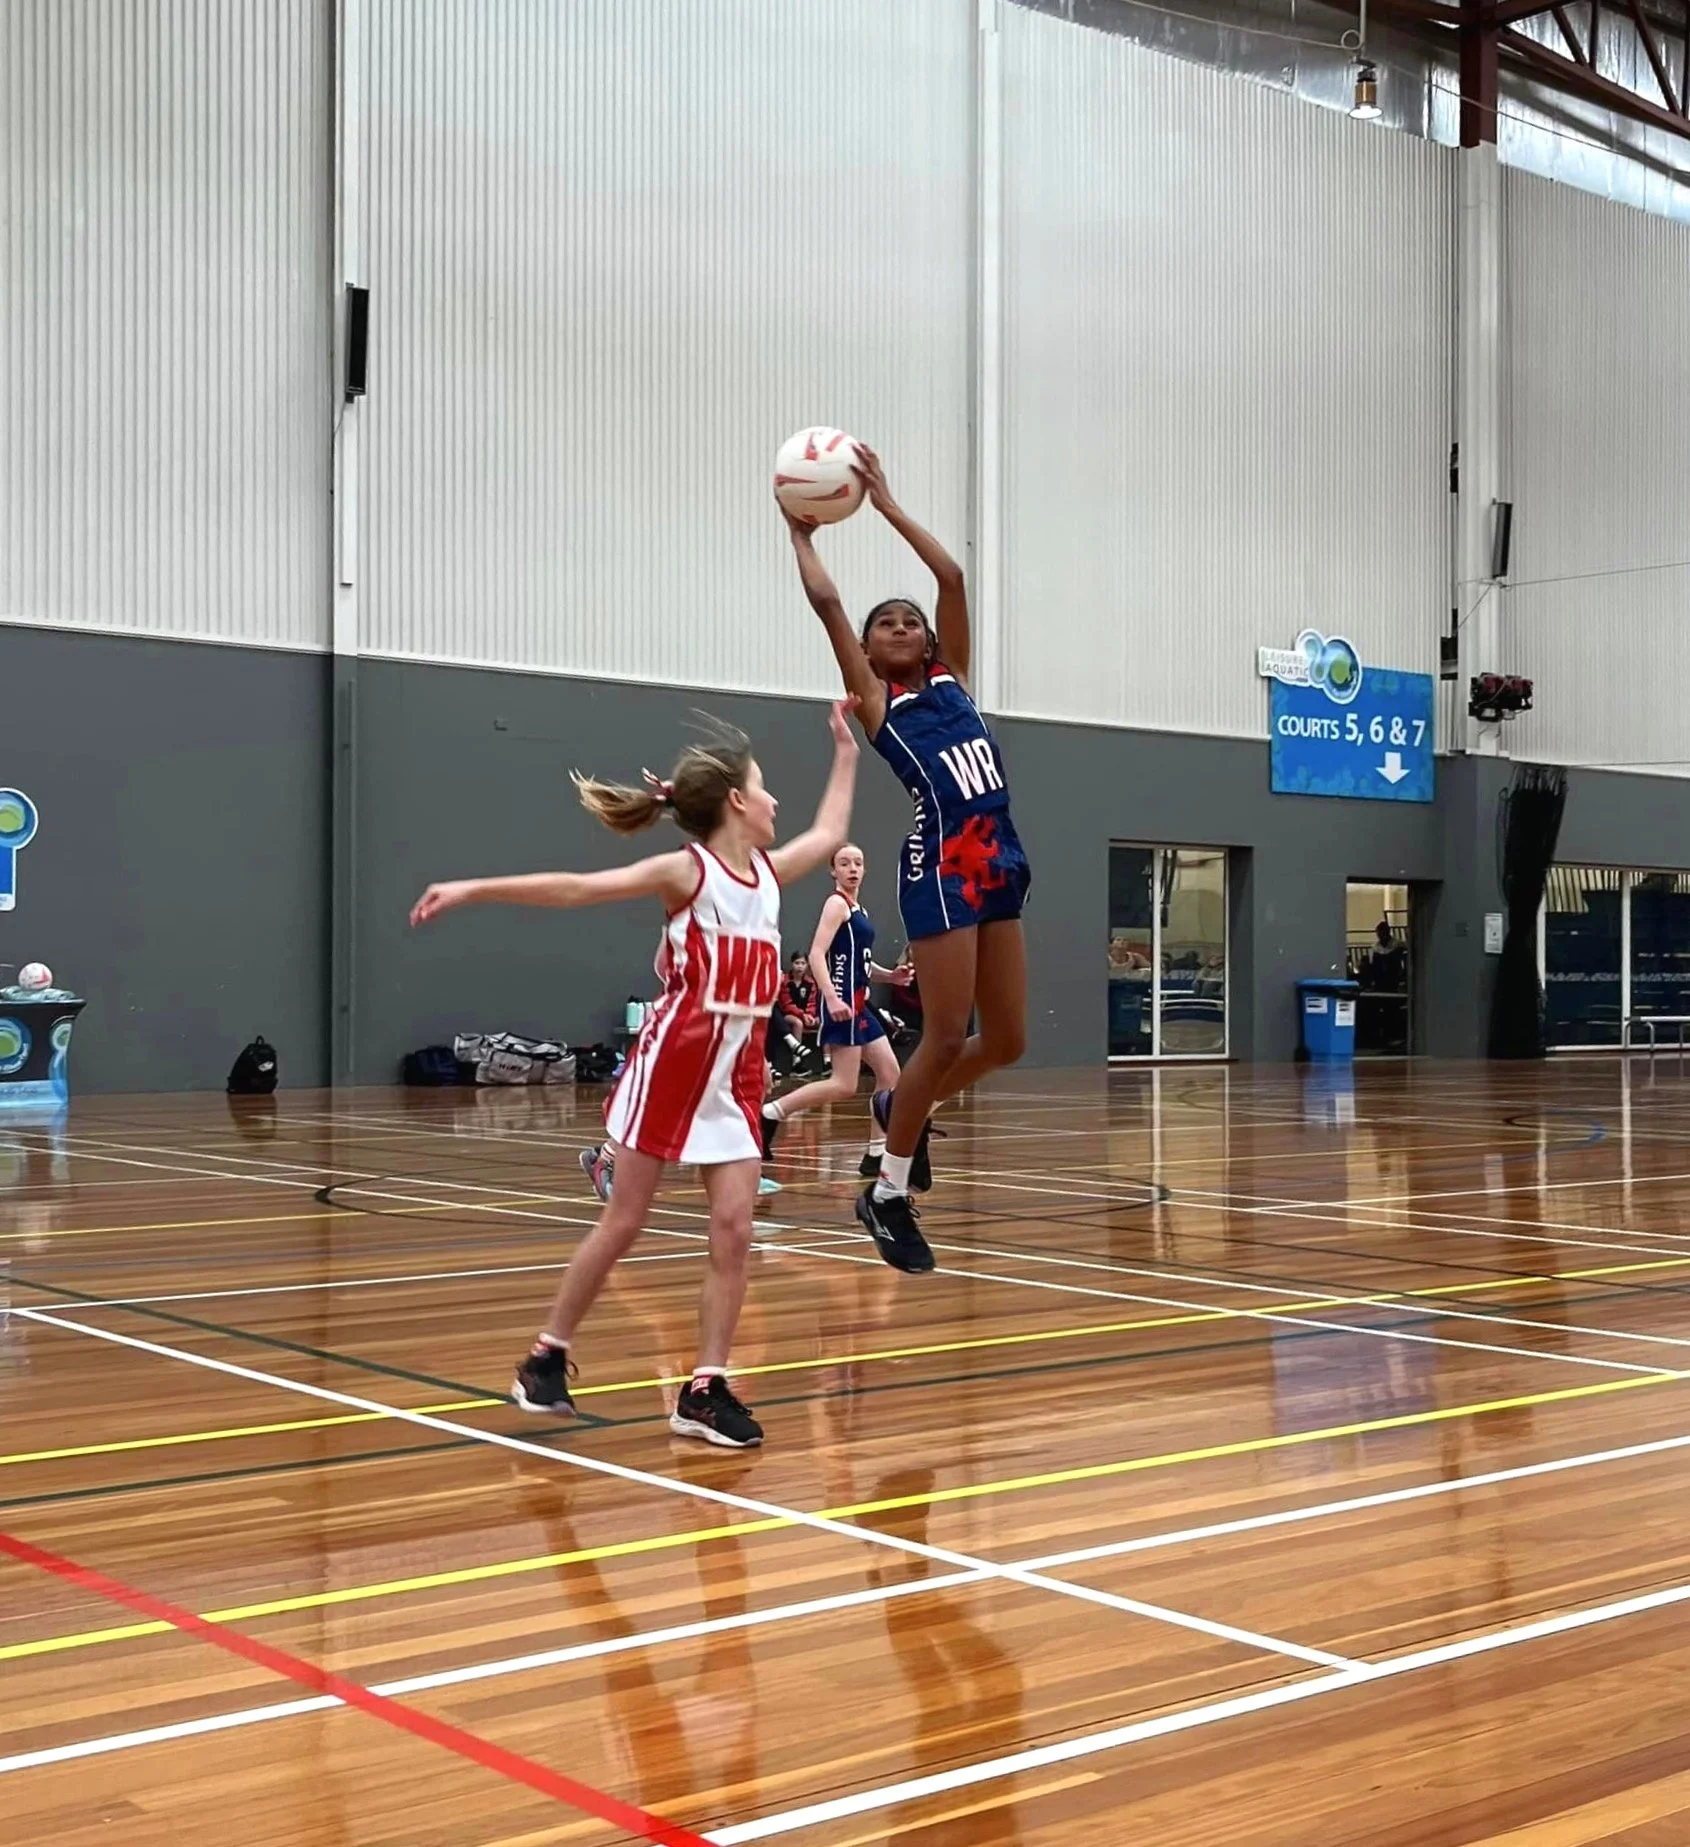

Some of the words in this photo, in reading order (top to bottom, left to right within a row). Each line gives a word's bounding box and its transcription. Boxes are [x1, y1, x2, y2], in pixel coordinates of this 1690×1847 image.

[1277, 715, 1340, 740] COURTS
[1345, 713, 1363, 746] 5,
[1369, 715, 1384, 743] 6
[1389, 716, 1406, 746] &
[1412, 719, 1426, 747] 7
[938, 737, 1004, 800] WR
[714, 934, 779, 1006] WD
